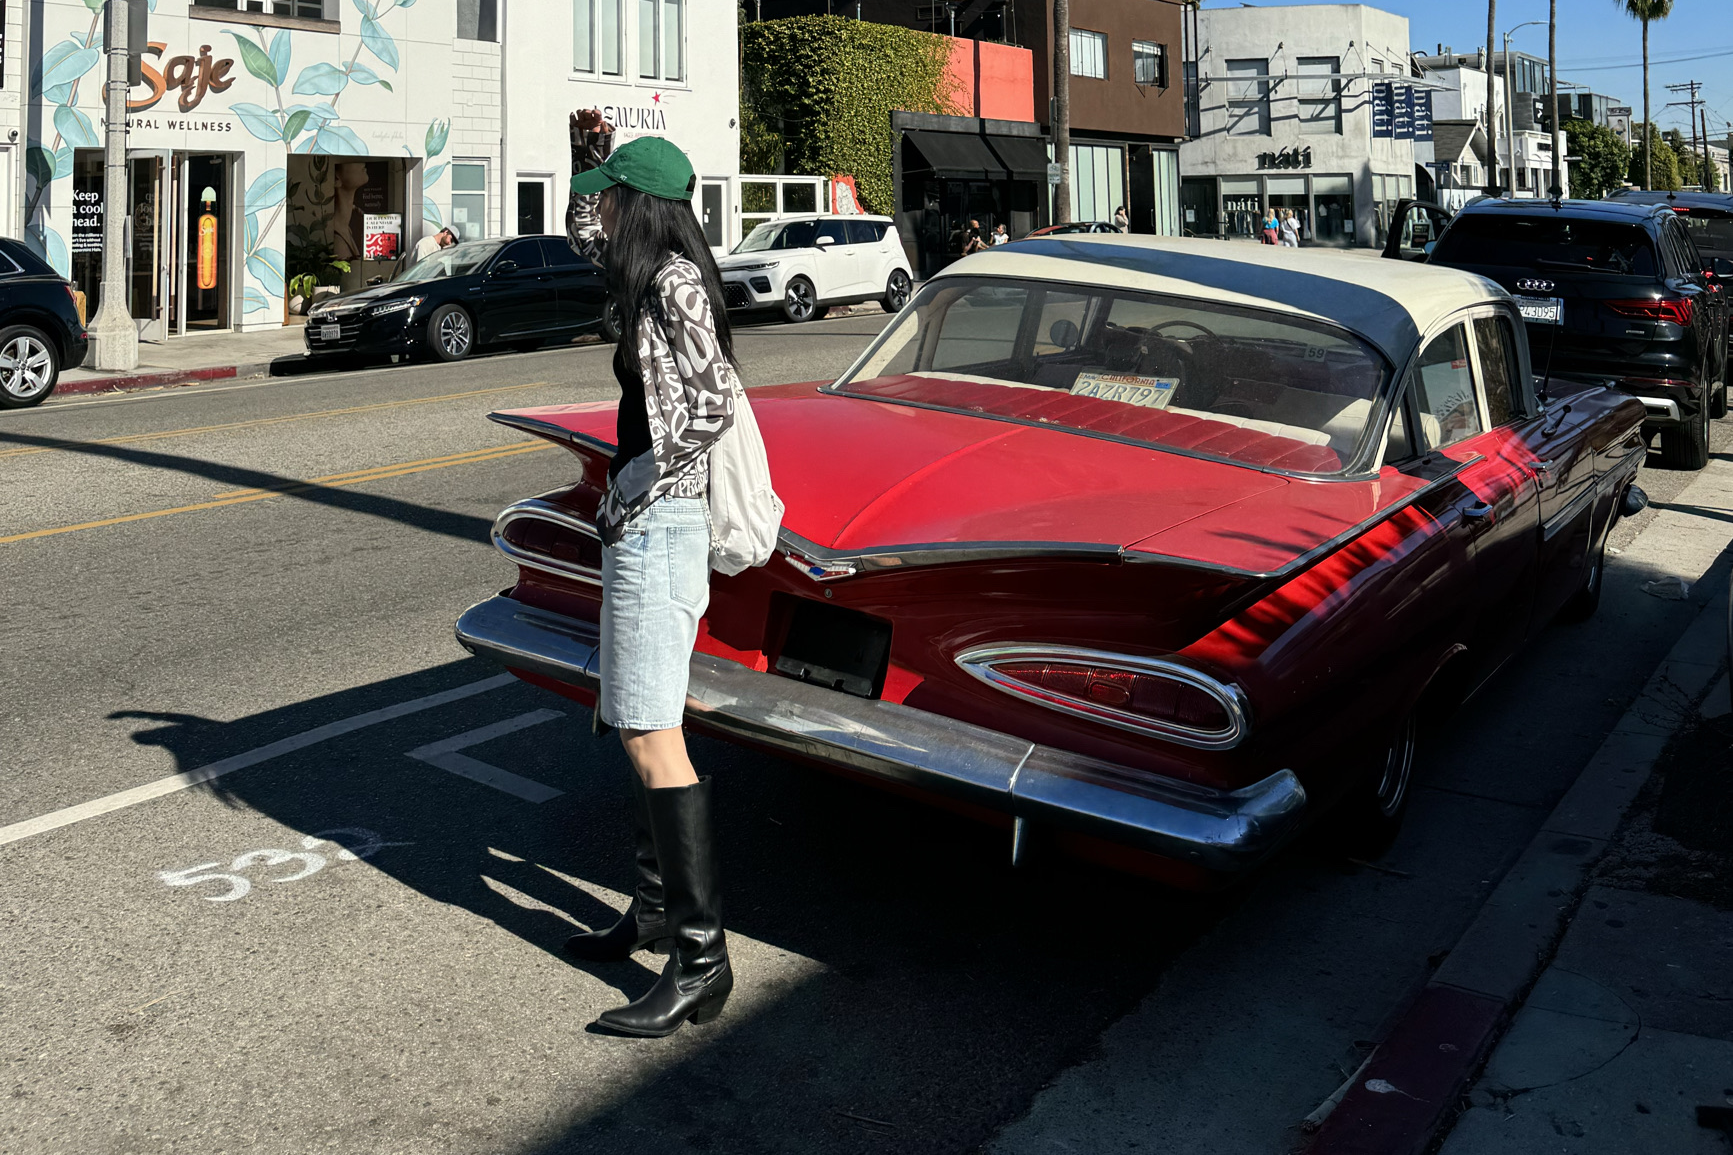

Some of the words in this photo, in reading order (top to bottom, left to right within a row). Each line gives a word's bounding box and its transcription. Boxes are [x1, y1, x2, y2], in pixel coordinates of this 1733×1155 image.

[102, 42, 236, 113] Saje
[1373, 86, 1392, 132] náti
[1394, 89, 1413, 135] náti
[1414, 92, 1432, 137] náti
[100, 118, 160, 130] NURAL
[167, 120, 232, 132] WELLNESS
[72, 190, 99, 204] Keep
[1227, 197, 1259, 211] náti
[80, 202, 104, 214] cool
[1307, 348, 1325, 359] 59
[1101, 374, 1155, 386] CALIFORNIA
[1075, 381, 1164, 405] 2AZR797
